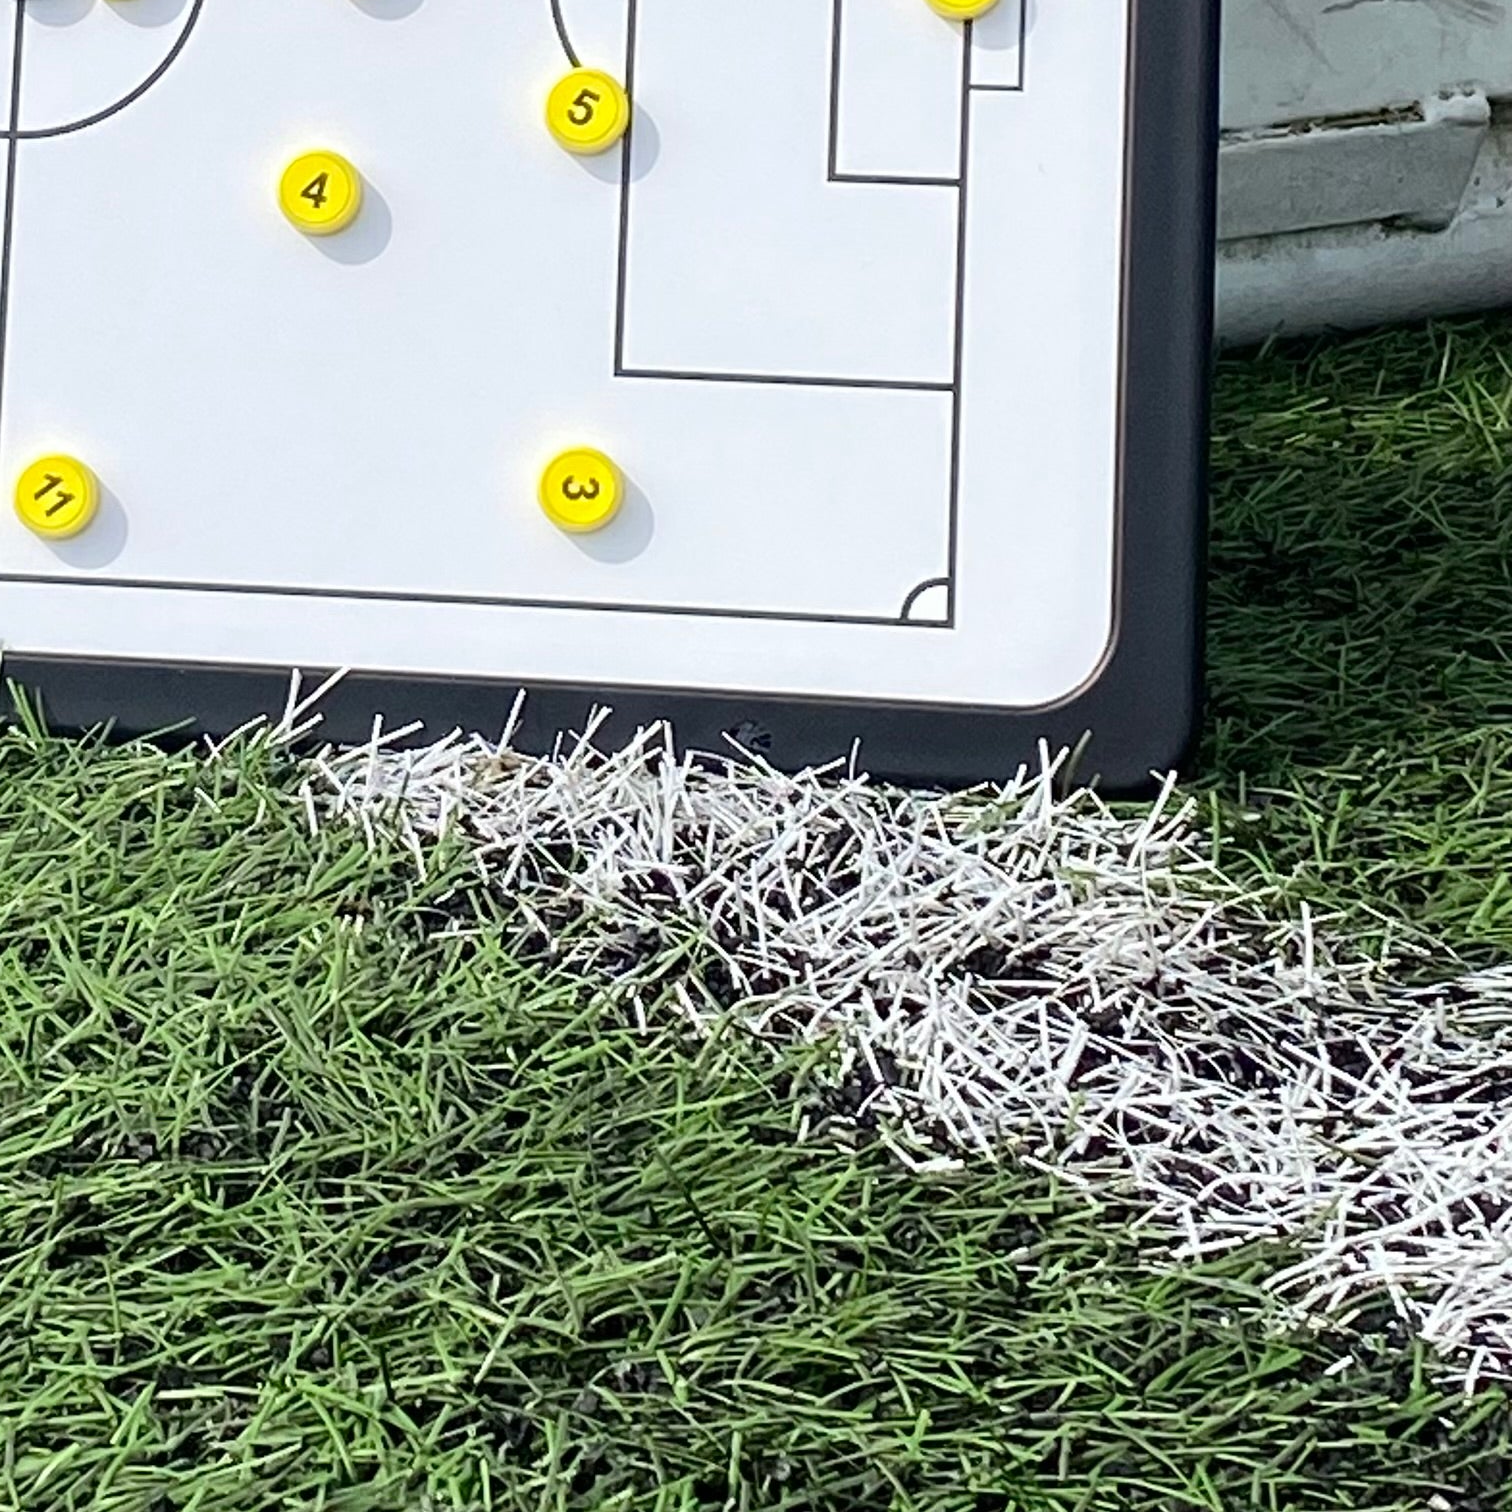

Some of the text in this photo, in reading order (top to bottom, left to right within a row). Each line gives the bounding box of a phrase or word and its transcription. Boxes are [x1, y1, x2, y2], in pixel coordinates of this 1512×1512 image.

[566, 87, 602, 127] 5
[299, 171, 330, 210] 4
[32, 472, 76, 519] 11
[560, 474, 601, 502] 3
